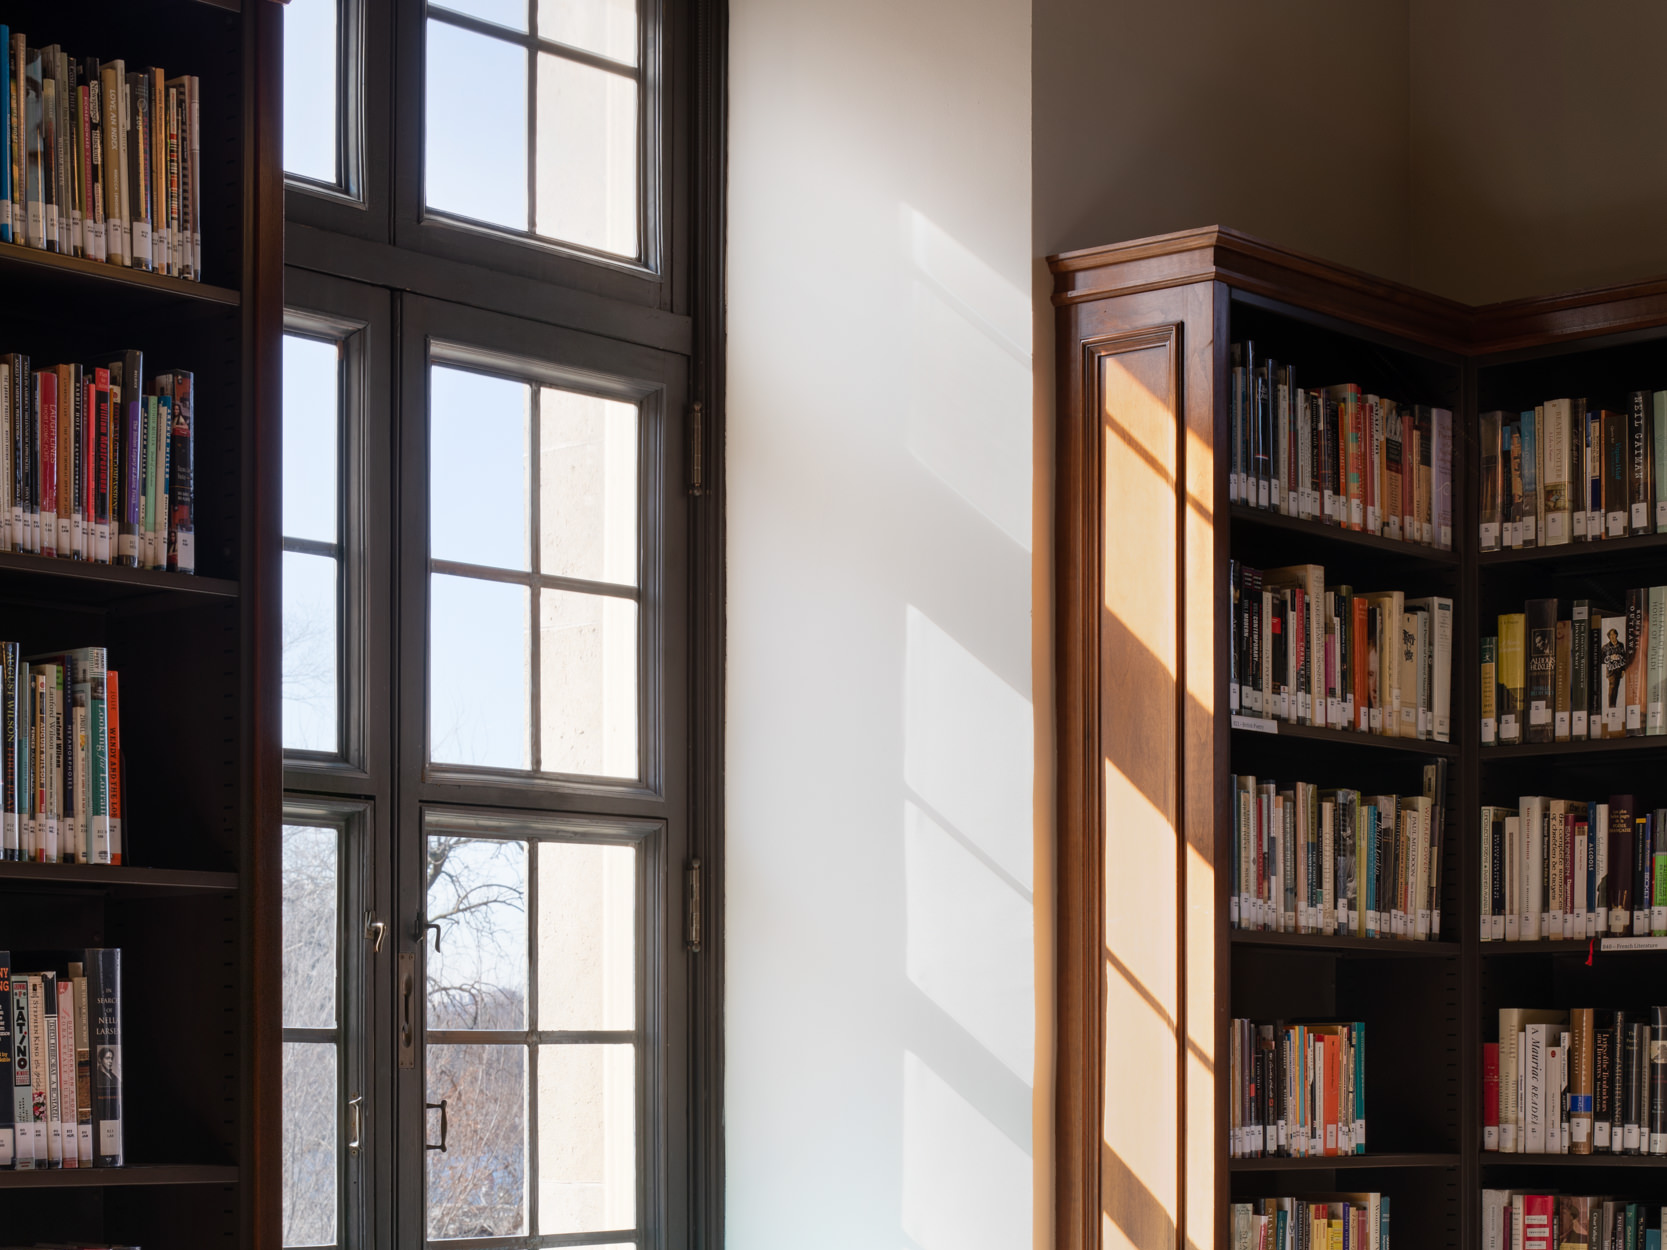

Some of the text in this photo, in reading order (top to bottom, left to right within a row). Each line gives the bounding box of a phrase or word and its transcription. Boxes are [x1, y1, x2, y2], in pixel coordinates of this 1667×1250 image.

[90, 83, 99, 122] Newspaper
[110, 112, 117, 125] AN
[1634, 396, 1643, 479] NEIL GAIMAN
[6, 651, 16, 698] AUGUST
[6, 700, 16, 742] WILSON
[48, 686, 56, 750] Lanford Wilson
[97, 703, 107, 752] Looking
[109, 727, 117, 760] WENDY
[110, 781, 118, 800] THE
[1531, 1037, 1542, 1083] Mauriac
